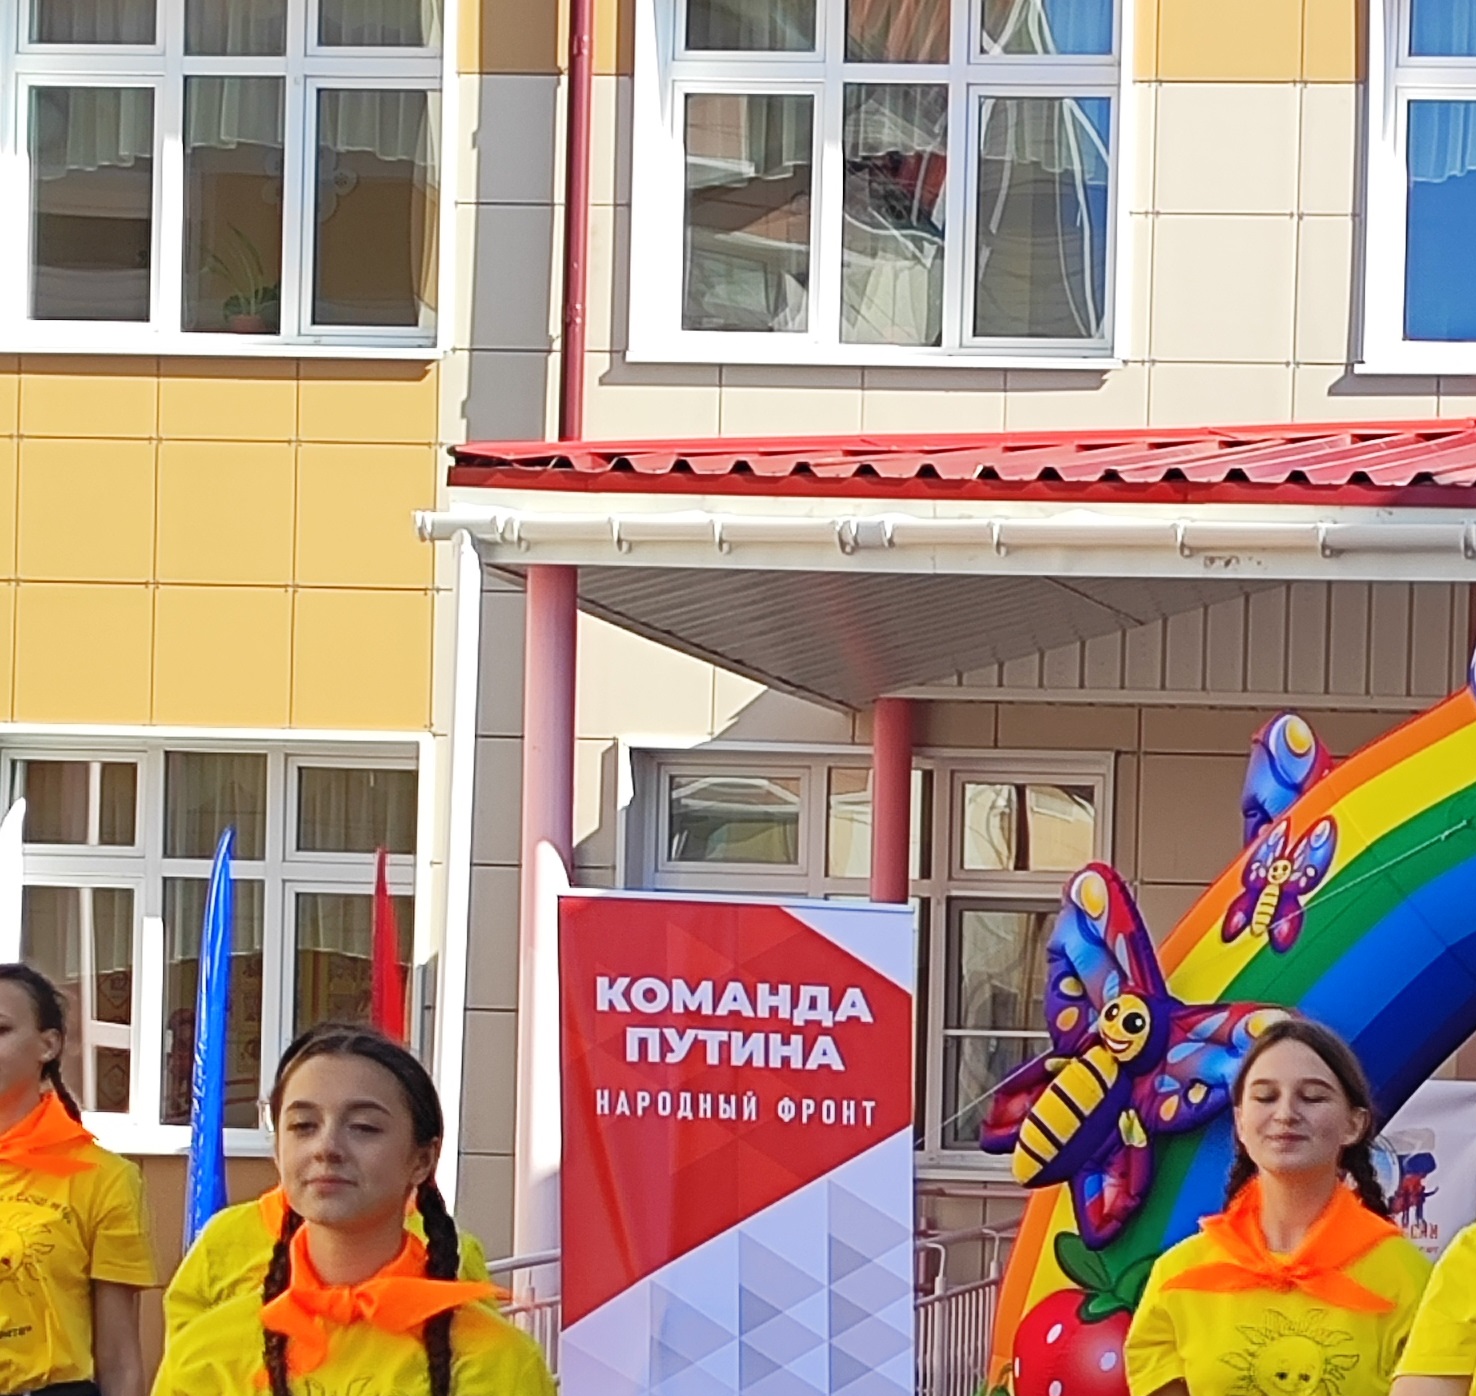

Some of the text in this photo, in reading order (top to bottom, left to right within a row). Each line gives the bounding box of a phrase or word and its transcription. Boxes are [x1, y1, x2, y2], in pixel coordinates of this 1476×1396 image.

[596, 976, 874, 1027] КОМАНДА
[625, 1026, 845, 1071] ПУТИНА
[596, 1088, 876, 1126] НАРОДНЫЙ ФРОНТ
